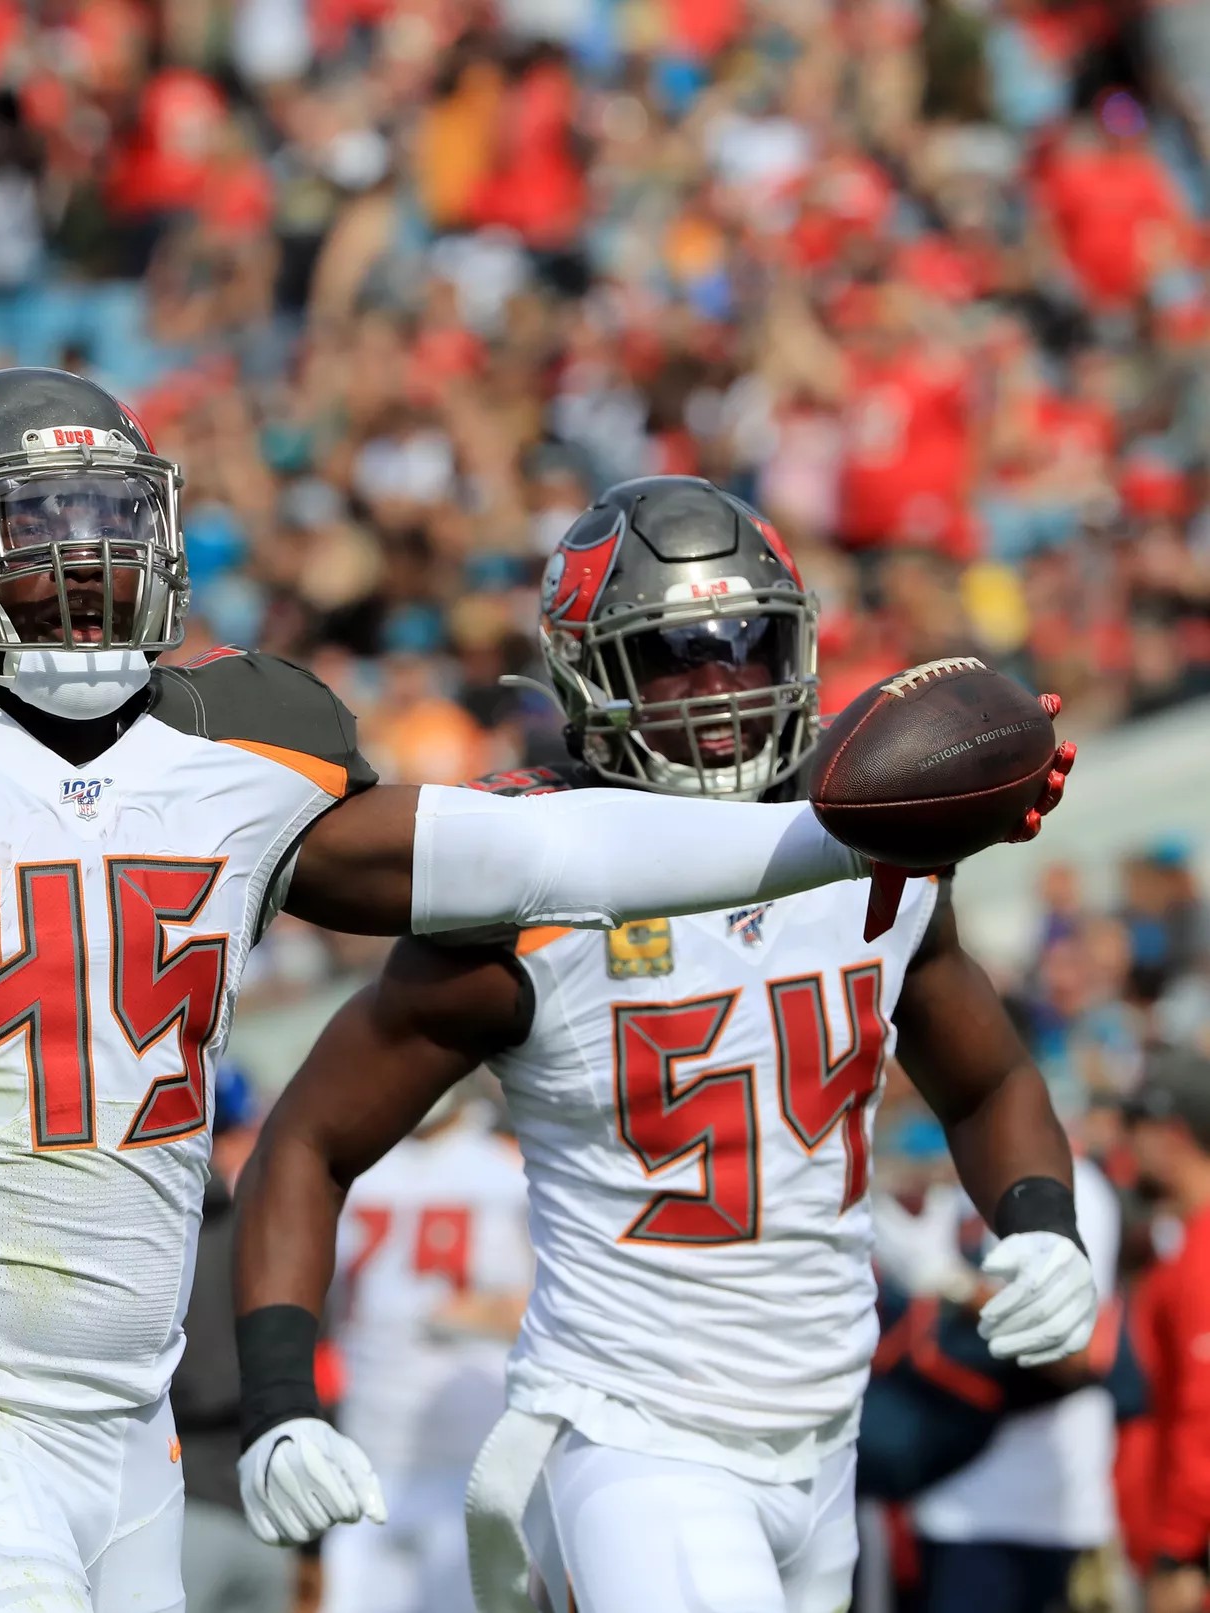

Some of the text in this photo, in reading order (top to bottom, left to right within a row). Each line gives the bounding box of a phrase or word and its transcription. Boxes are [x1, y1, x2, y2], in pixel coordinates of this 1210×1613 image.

[918, 741, 973, 772] NATIONAL
[975, 724, 1021, 745] FOOTBALL
[610, 958, 889, 1248] 54
